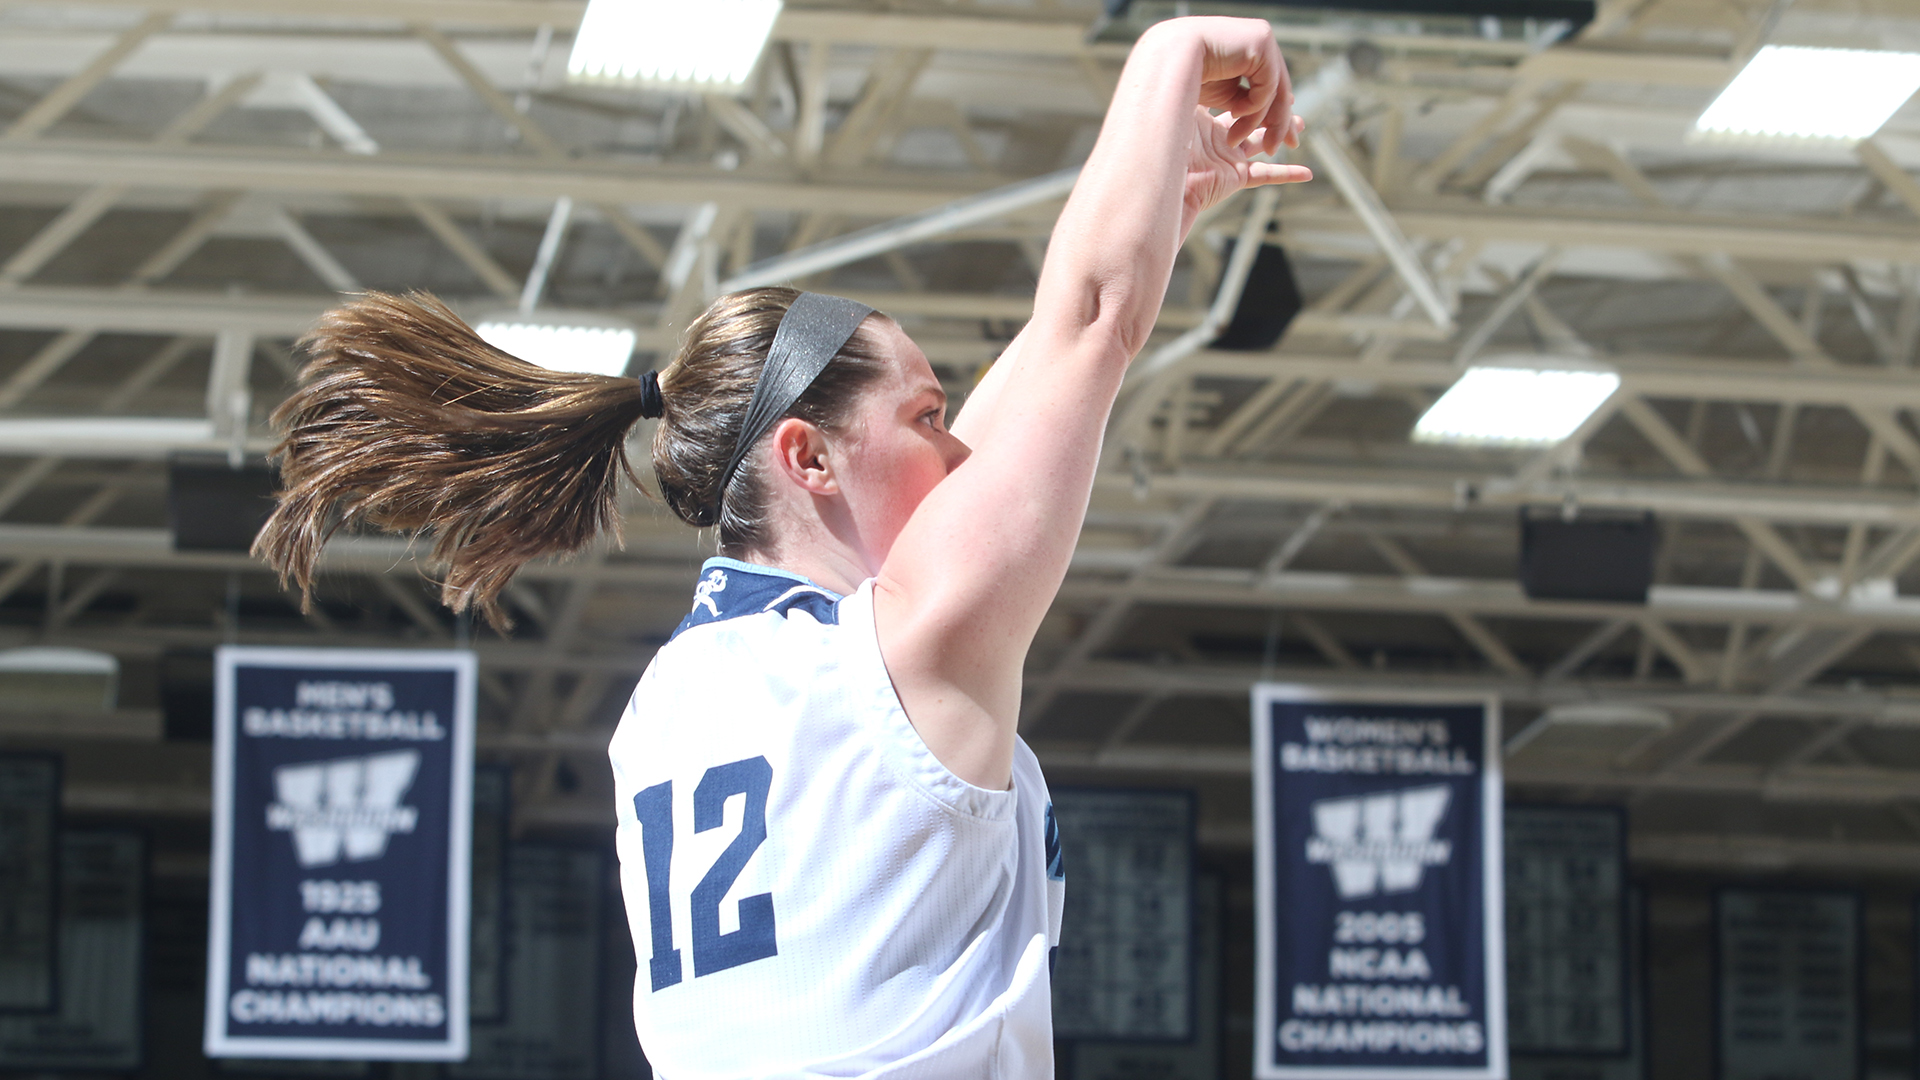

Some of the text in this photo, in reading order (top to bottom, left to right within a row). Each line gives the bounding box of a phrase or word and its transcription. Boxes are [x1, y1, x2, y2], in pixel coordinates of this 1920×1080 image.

[296, 682, 394, 710] MEN'S
[244, 707, 445, 740] BASKETBALL
[1304, 716, 1448, 745] WOMEN'S
[1281, 742, 1474, 775] BASKETBALL
[633, 755, 778, 993] 12
[300, 880, 381, 914] 1925
[298, 917, 380, 950] AAU
[1334, 911, 1425, 944] 2005
[246, 952, 431, 989] NATIONAL
[1328, 947, 1431, 980] NCAA
[230, 989, 445, 1027] CHAMPIONS
[1293, 983, 1470, 1017] NATIONAL
[1279, 1019, 1483, 1054] CHAMPIONS
